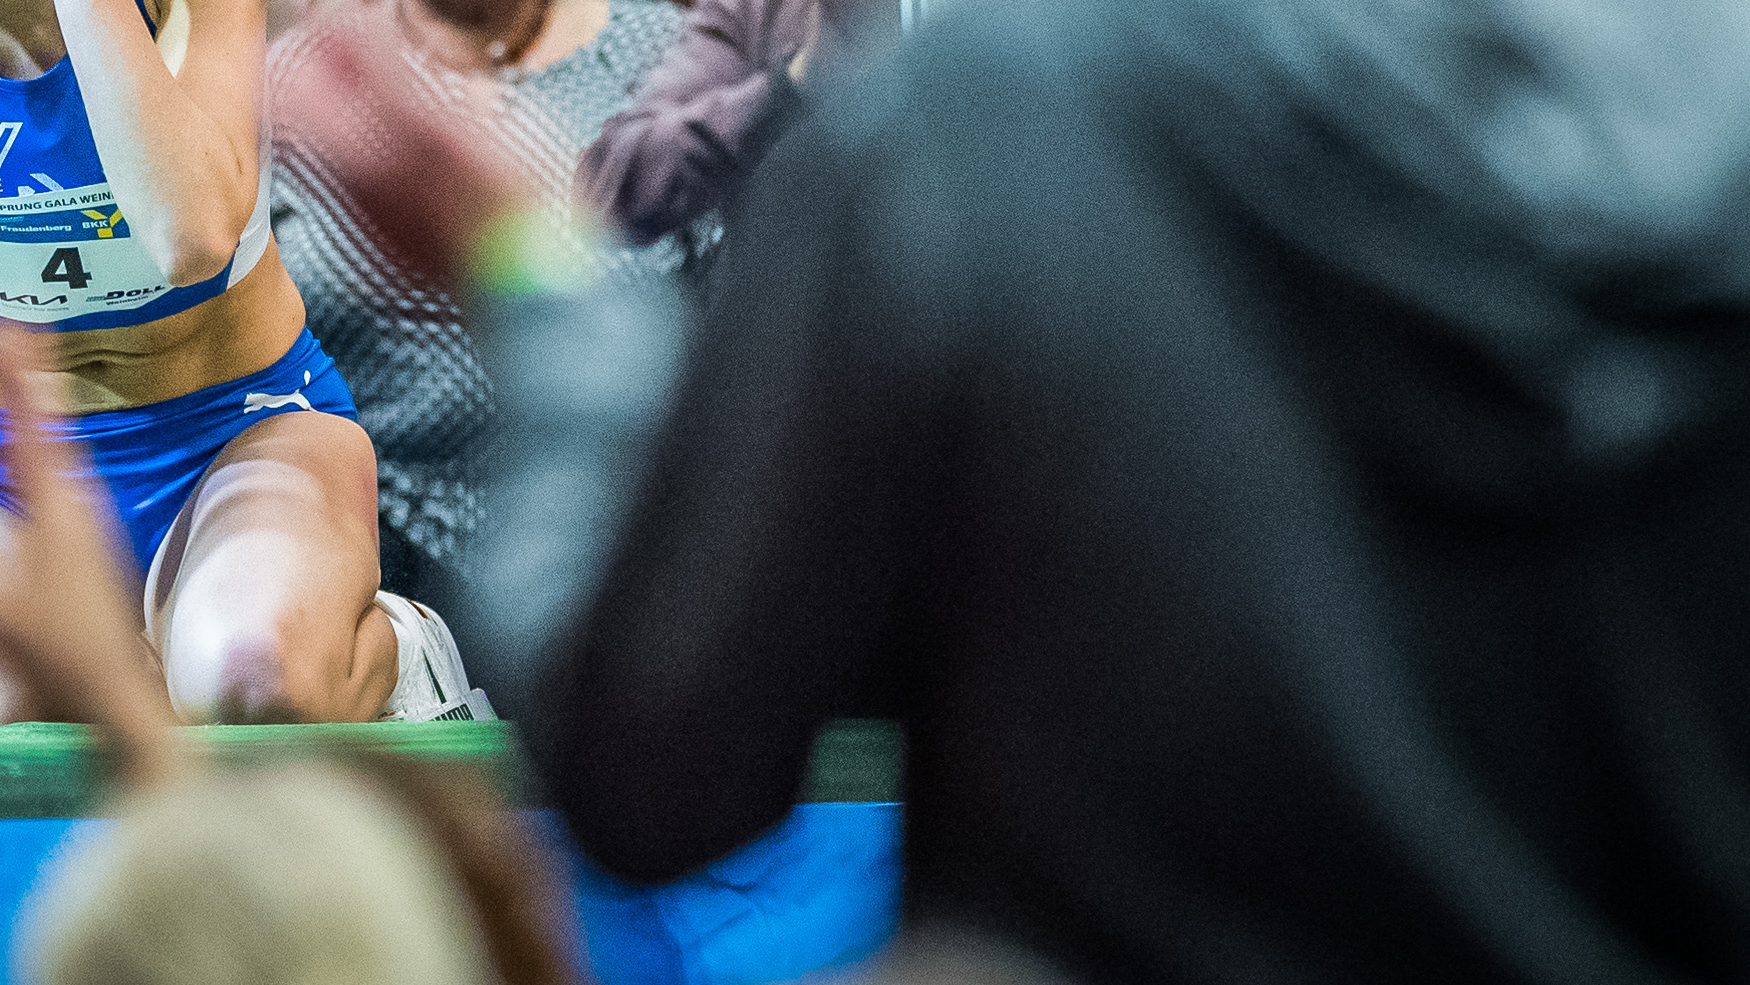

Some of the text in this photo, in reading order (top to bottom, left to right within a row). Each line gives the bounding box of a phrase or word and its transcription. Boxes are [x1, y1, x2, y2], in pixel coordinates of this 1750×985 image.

[44, 197, 78, 208] GALA
[79, 191, 115, 205] WEIN
[0, 220, 108, 233] Freudenberg BKK
[40, 247, 92, 290] 4
[0, 291, 68, 306] KIA
